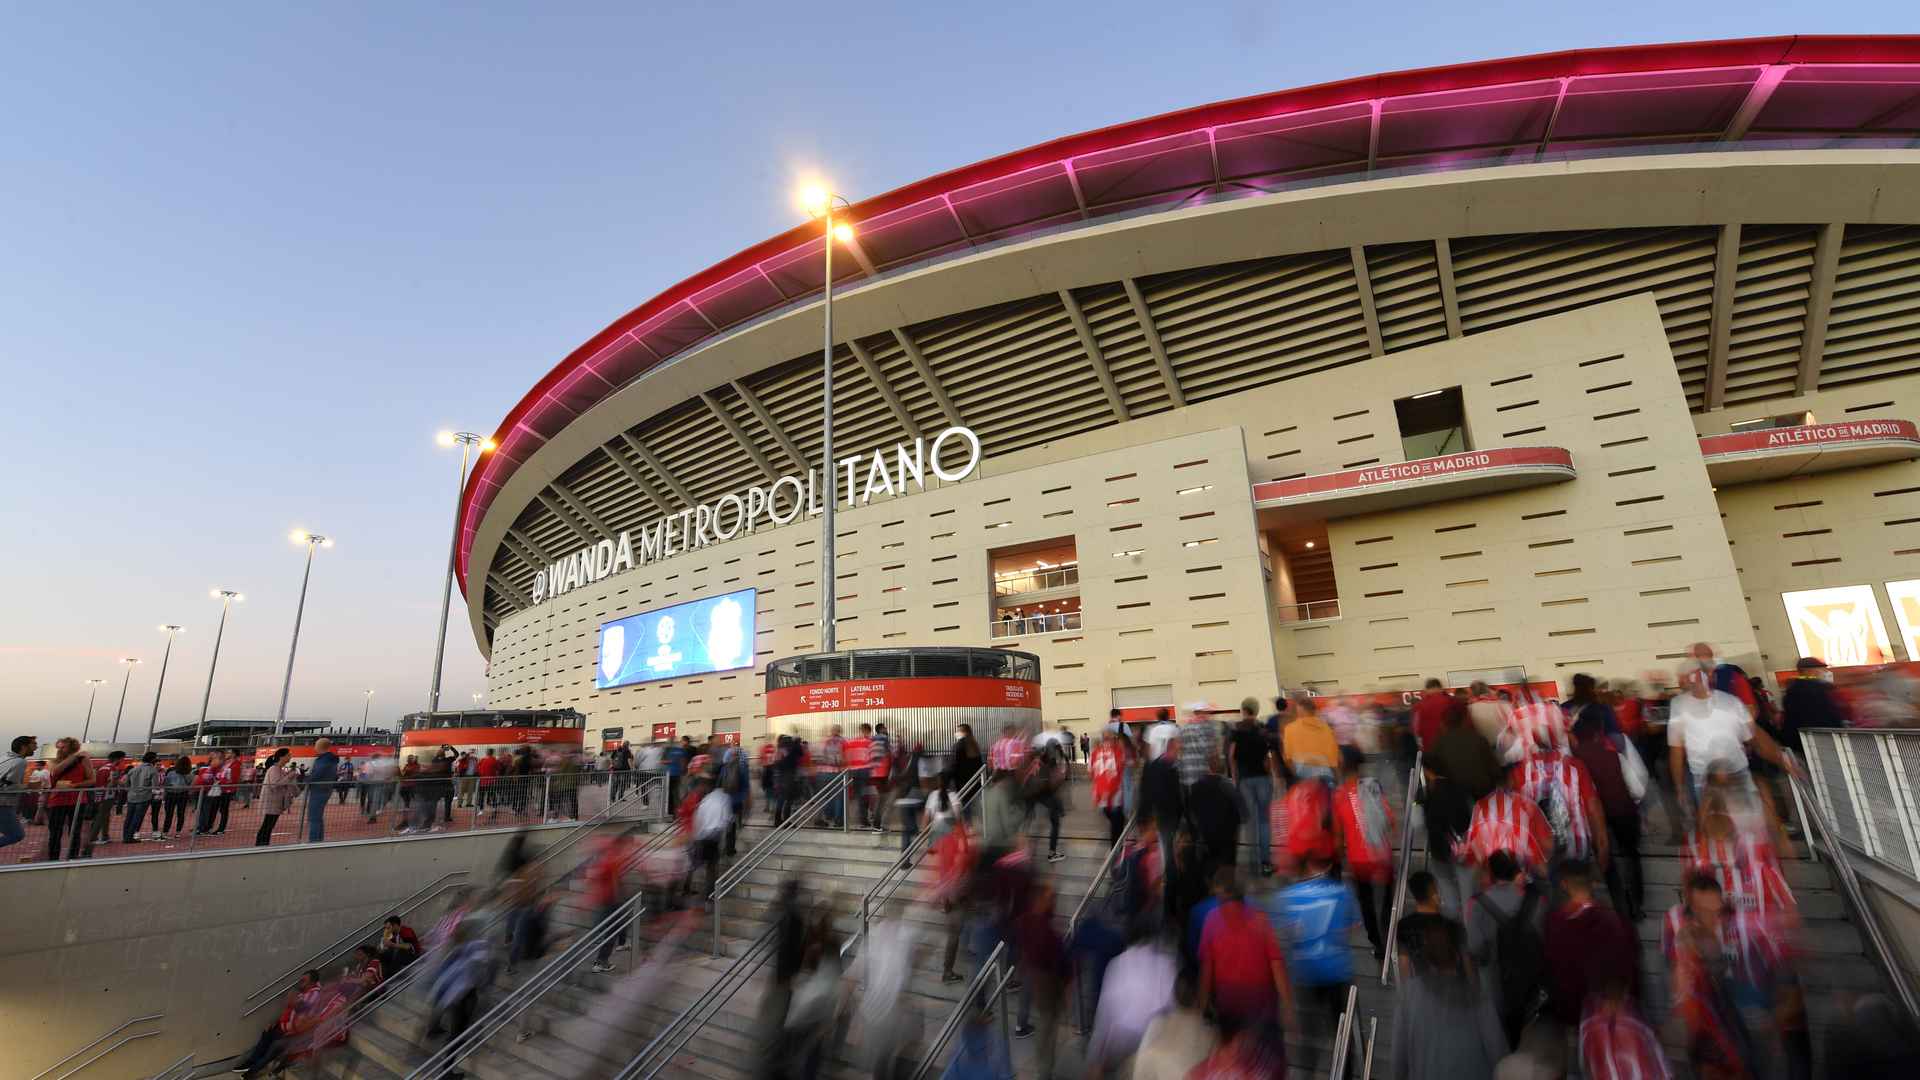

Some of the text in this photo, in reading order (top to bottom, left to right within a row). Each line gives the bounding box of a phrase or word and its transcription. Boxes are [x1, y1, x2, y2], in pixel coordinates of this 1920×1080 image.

[1850, 423, 1901, 436] MADRID
[1433, 454, 1490, 472] MADRID
[549, 531, 636, 598] WANDA
[865, 697, 885, 706] 31-34
